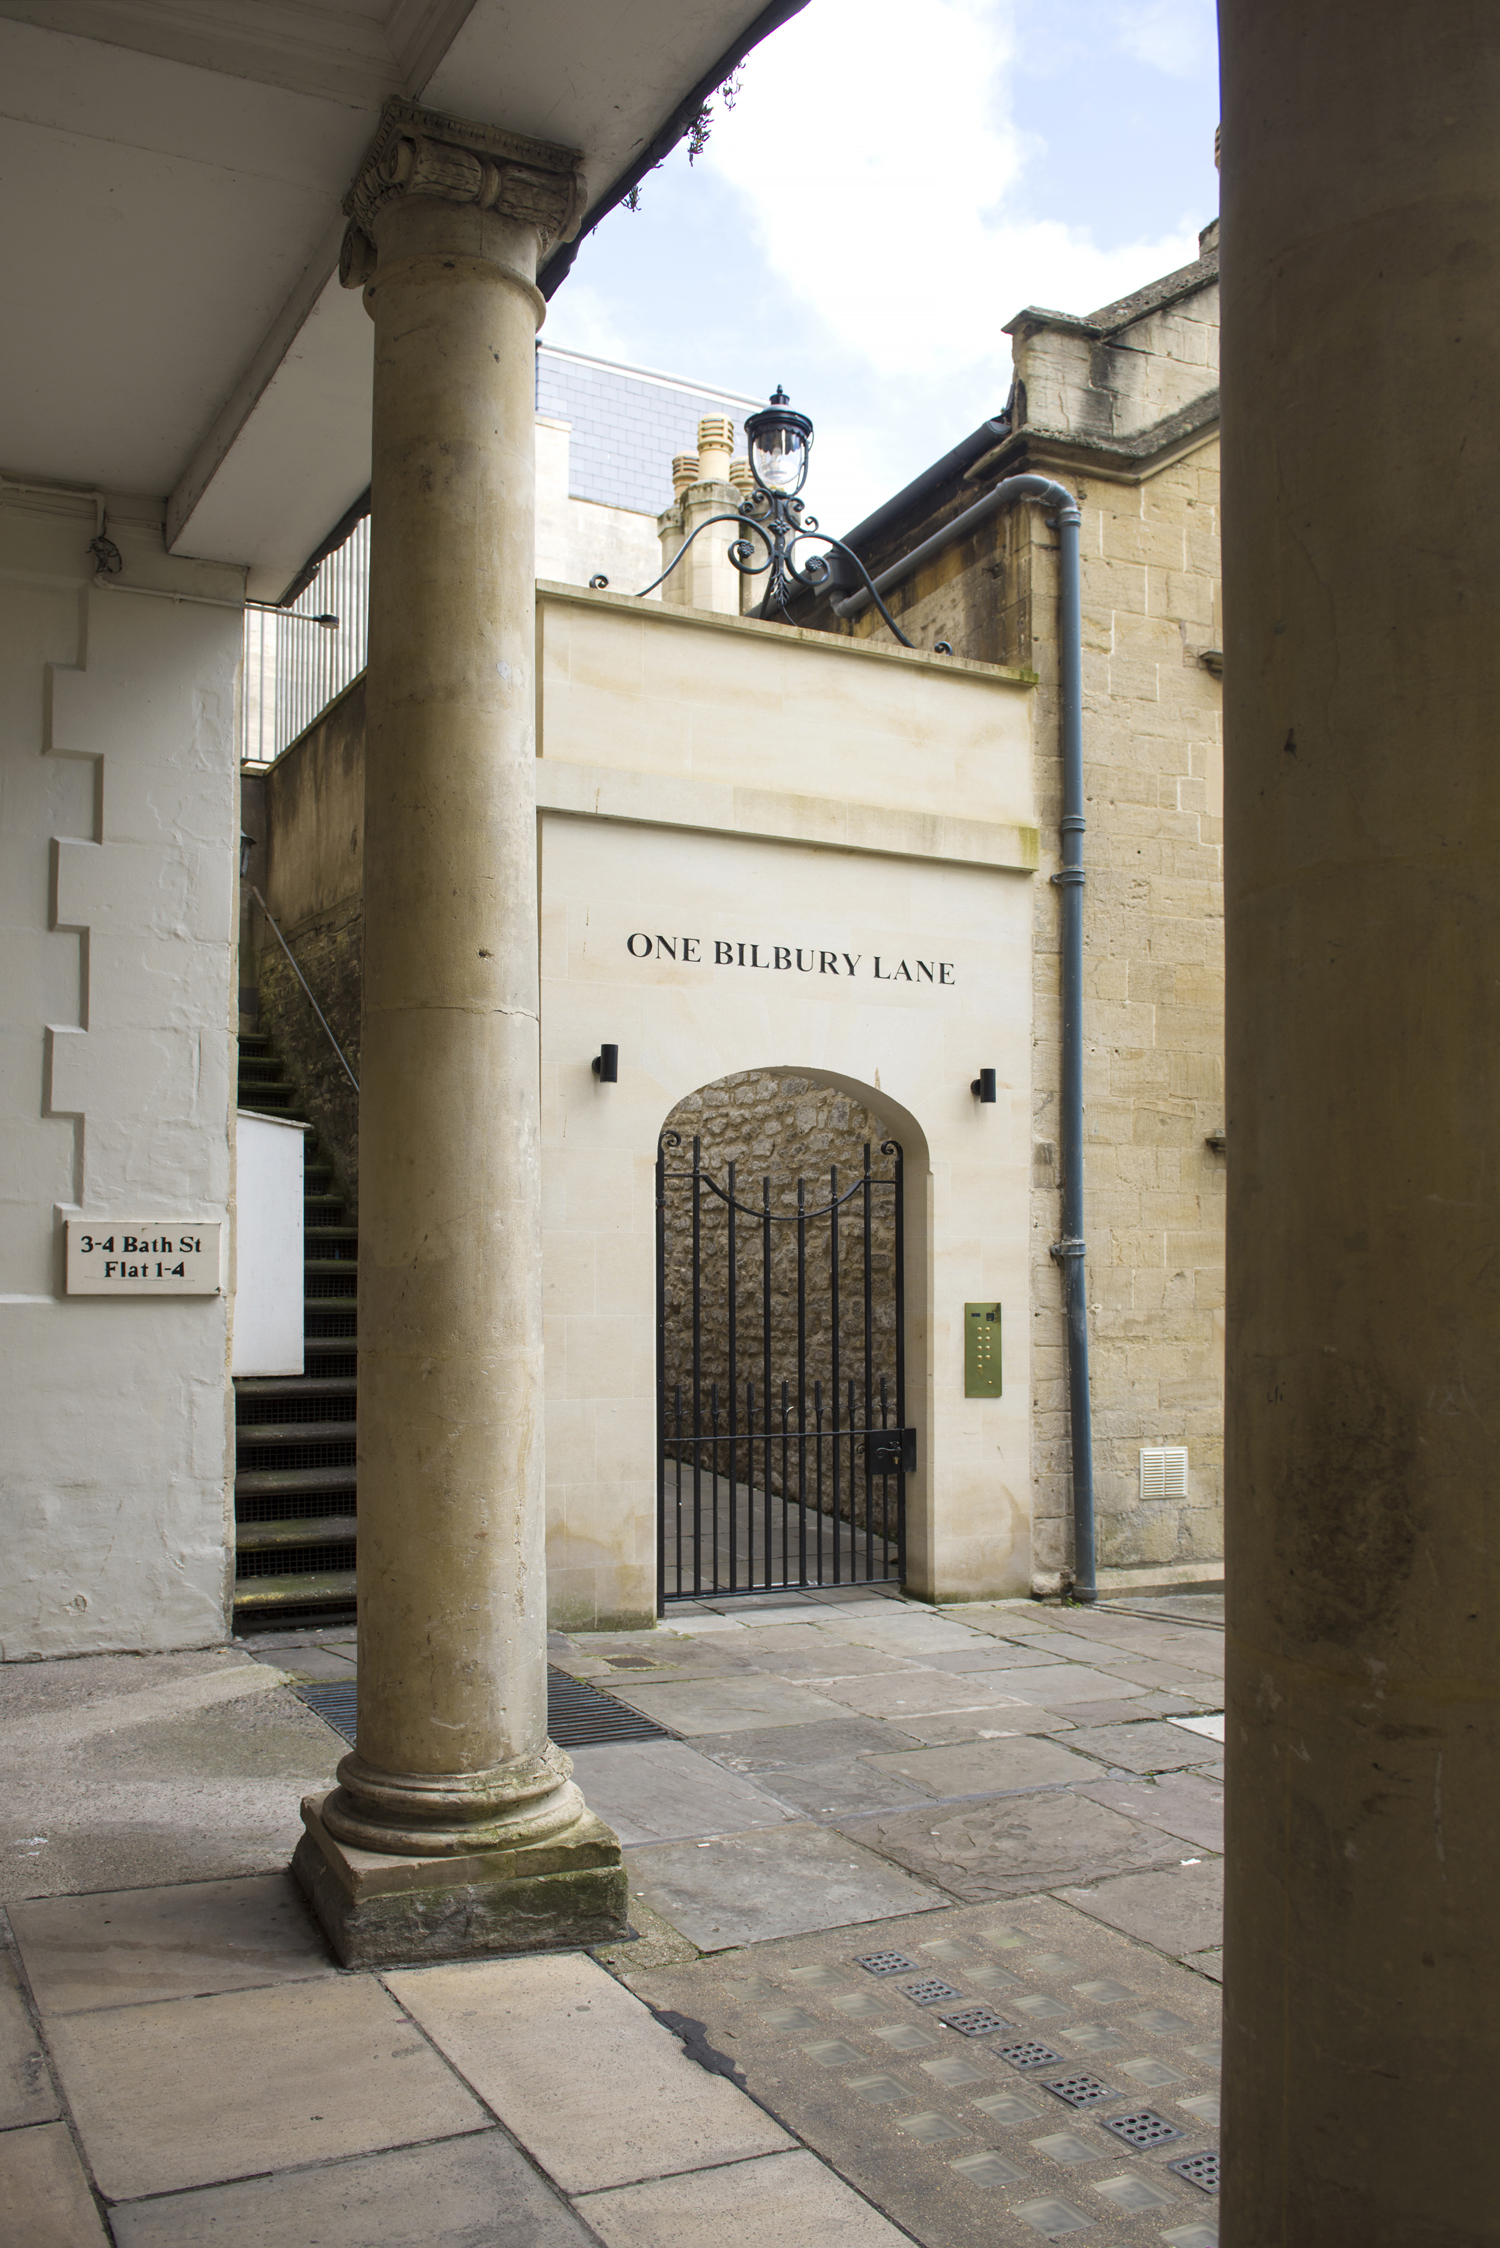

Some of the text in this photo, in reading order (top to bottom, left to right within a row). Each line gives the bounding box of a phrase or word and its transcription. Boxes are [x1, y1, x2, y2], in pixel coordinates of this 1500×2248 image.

[626, 932, 956, 985] ONE BILBURY LANE
[80, 1235, 202, 1253] 3-4 Bath St
[104, 1260, 185, 1278] Flat 1-4
